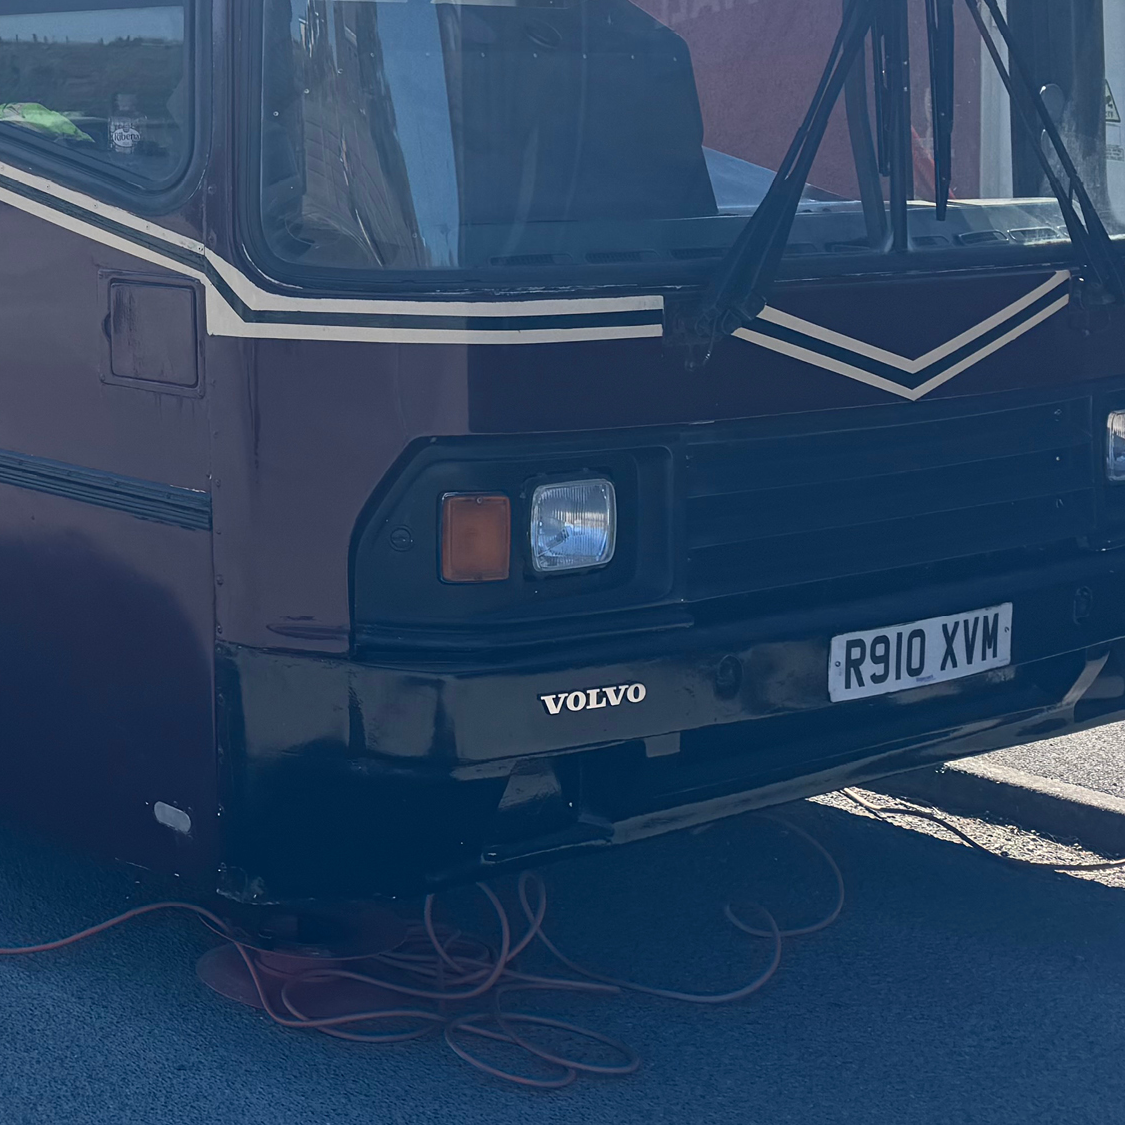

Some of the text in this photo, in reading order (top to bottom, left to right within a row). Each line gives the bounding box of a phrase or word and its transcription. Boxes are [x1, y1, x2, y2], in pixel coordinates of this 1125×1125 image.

[114, 132, 140, 142] Ribena
[844, 612, 999, 690] R910 XVM
[540, 682, 647, 715] VOLVO
